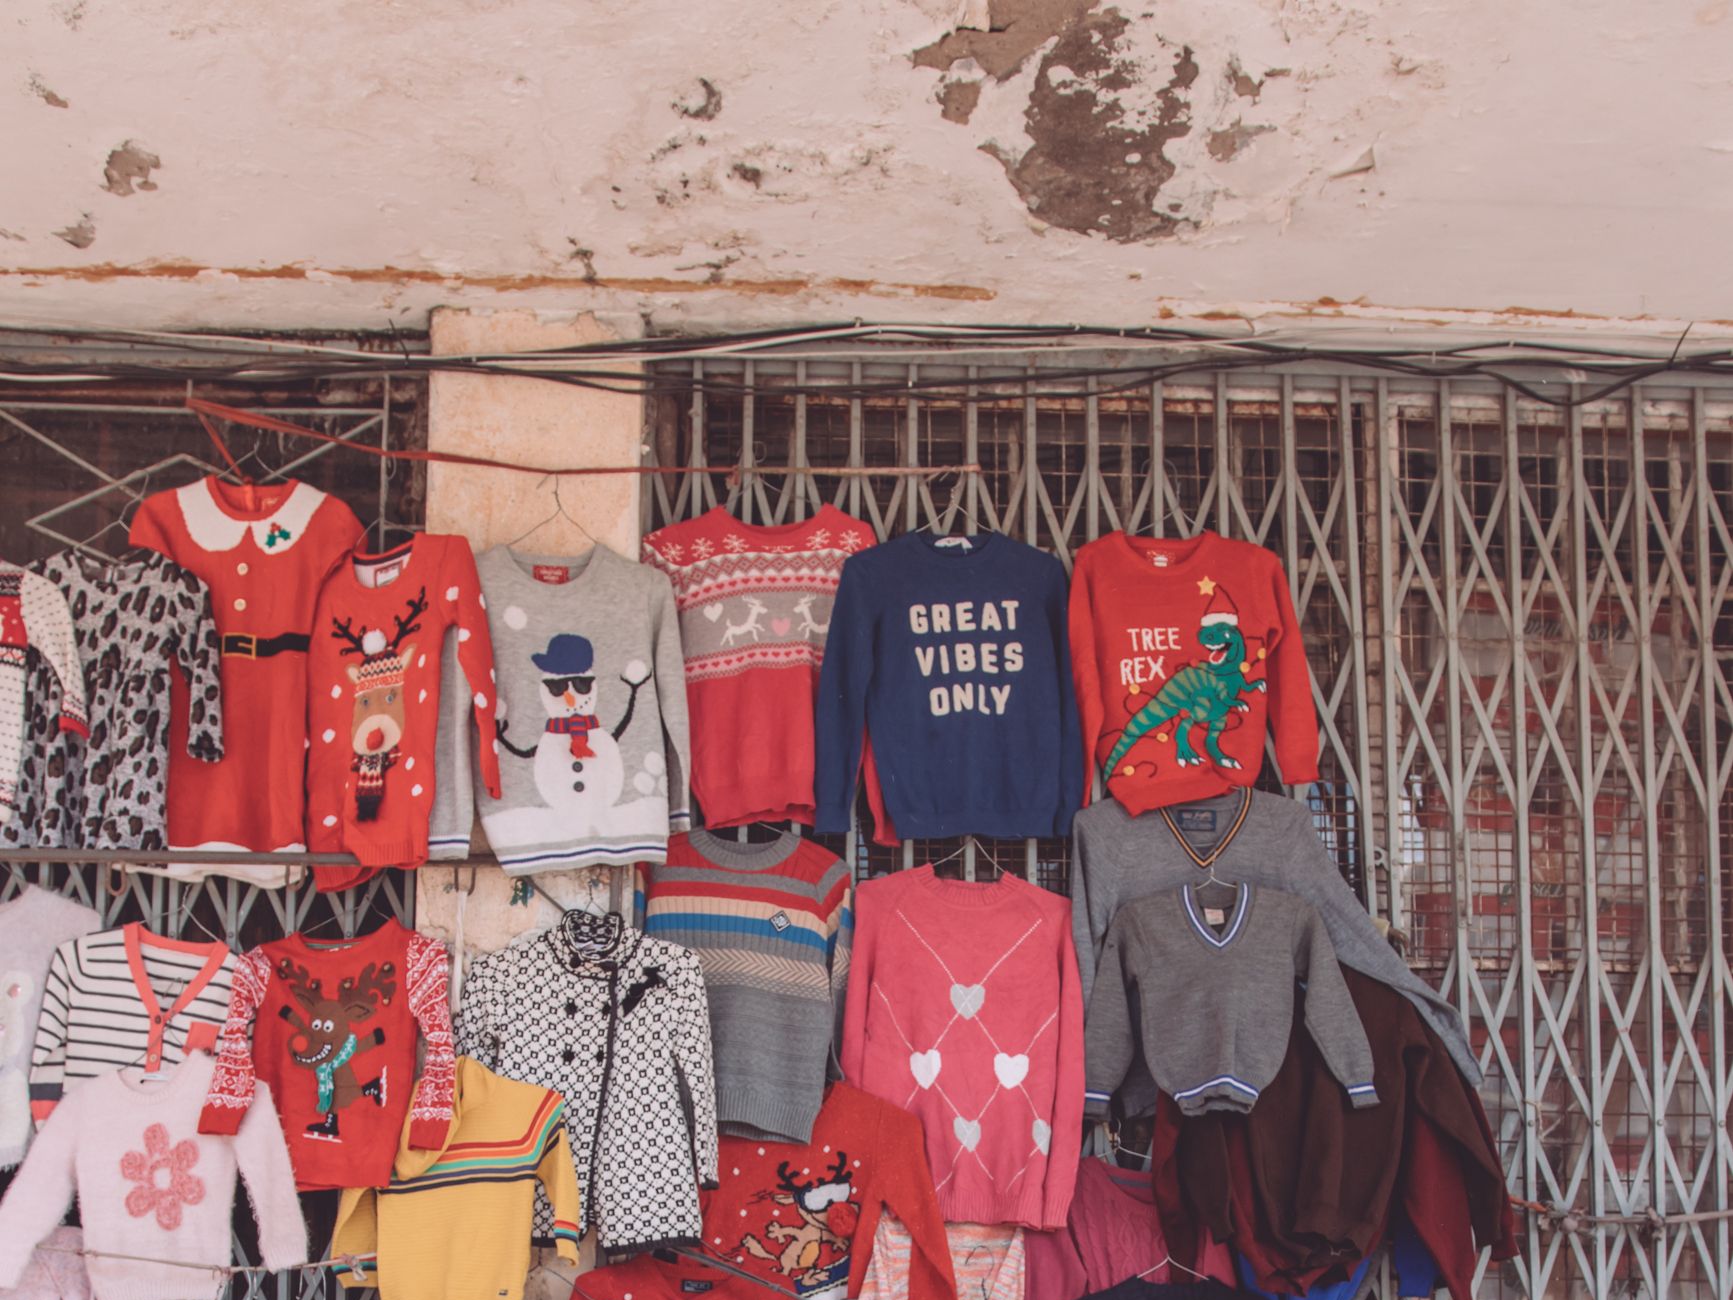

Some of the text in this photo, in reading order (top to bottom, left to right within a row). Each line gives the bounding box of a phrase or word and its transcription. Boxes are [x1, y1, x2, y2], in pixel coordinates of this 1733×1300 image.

[909, 600, 1019, 634] GREAT
[1126, 627, 1182, 651] TREE
[914, 642, 1024, 677] VIBES
[1120, 655, 1166, 686] REX
[929, 682, 1011, 717] ONLY
